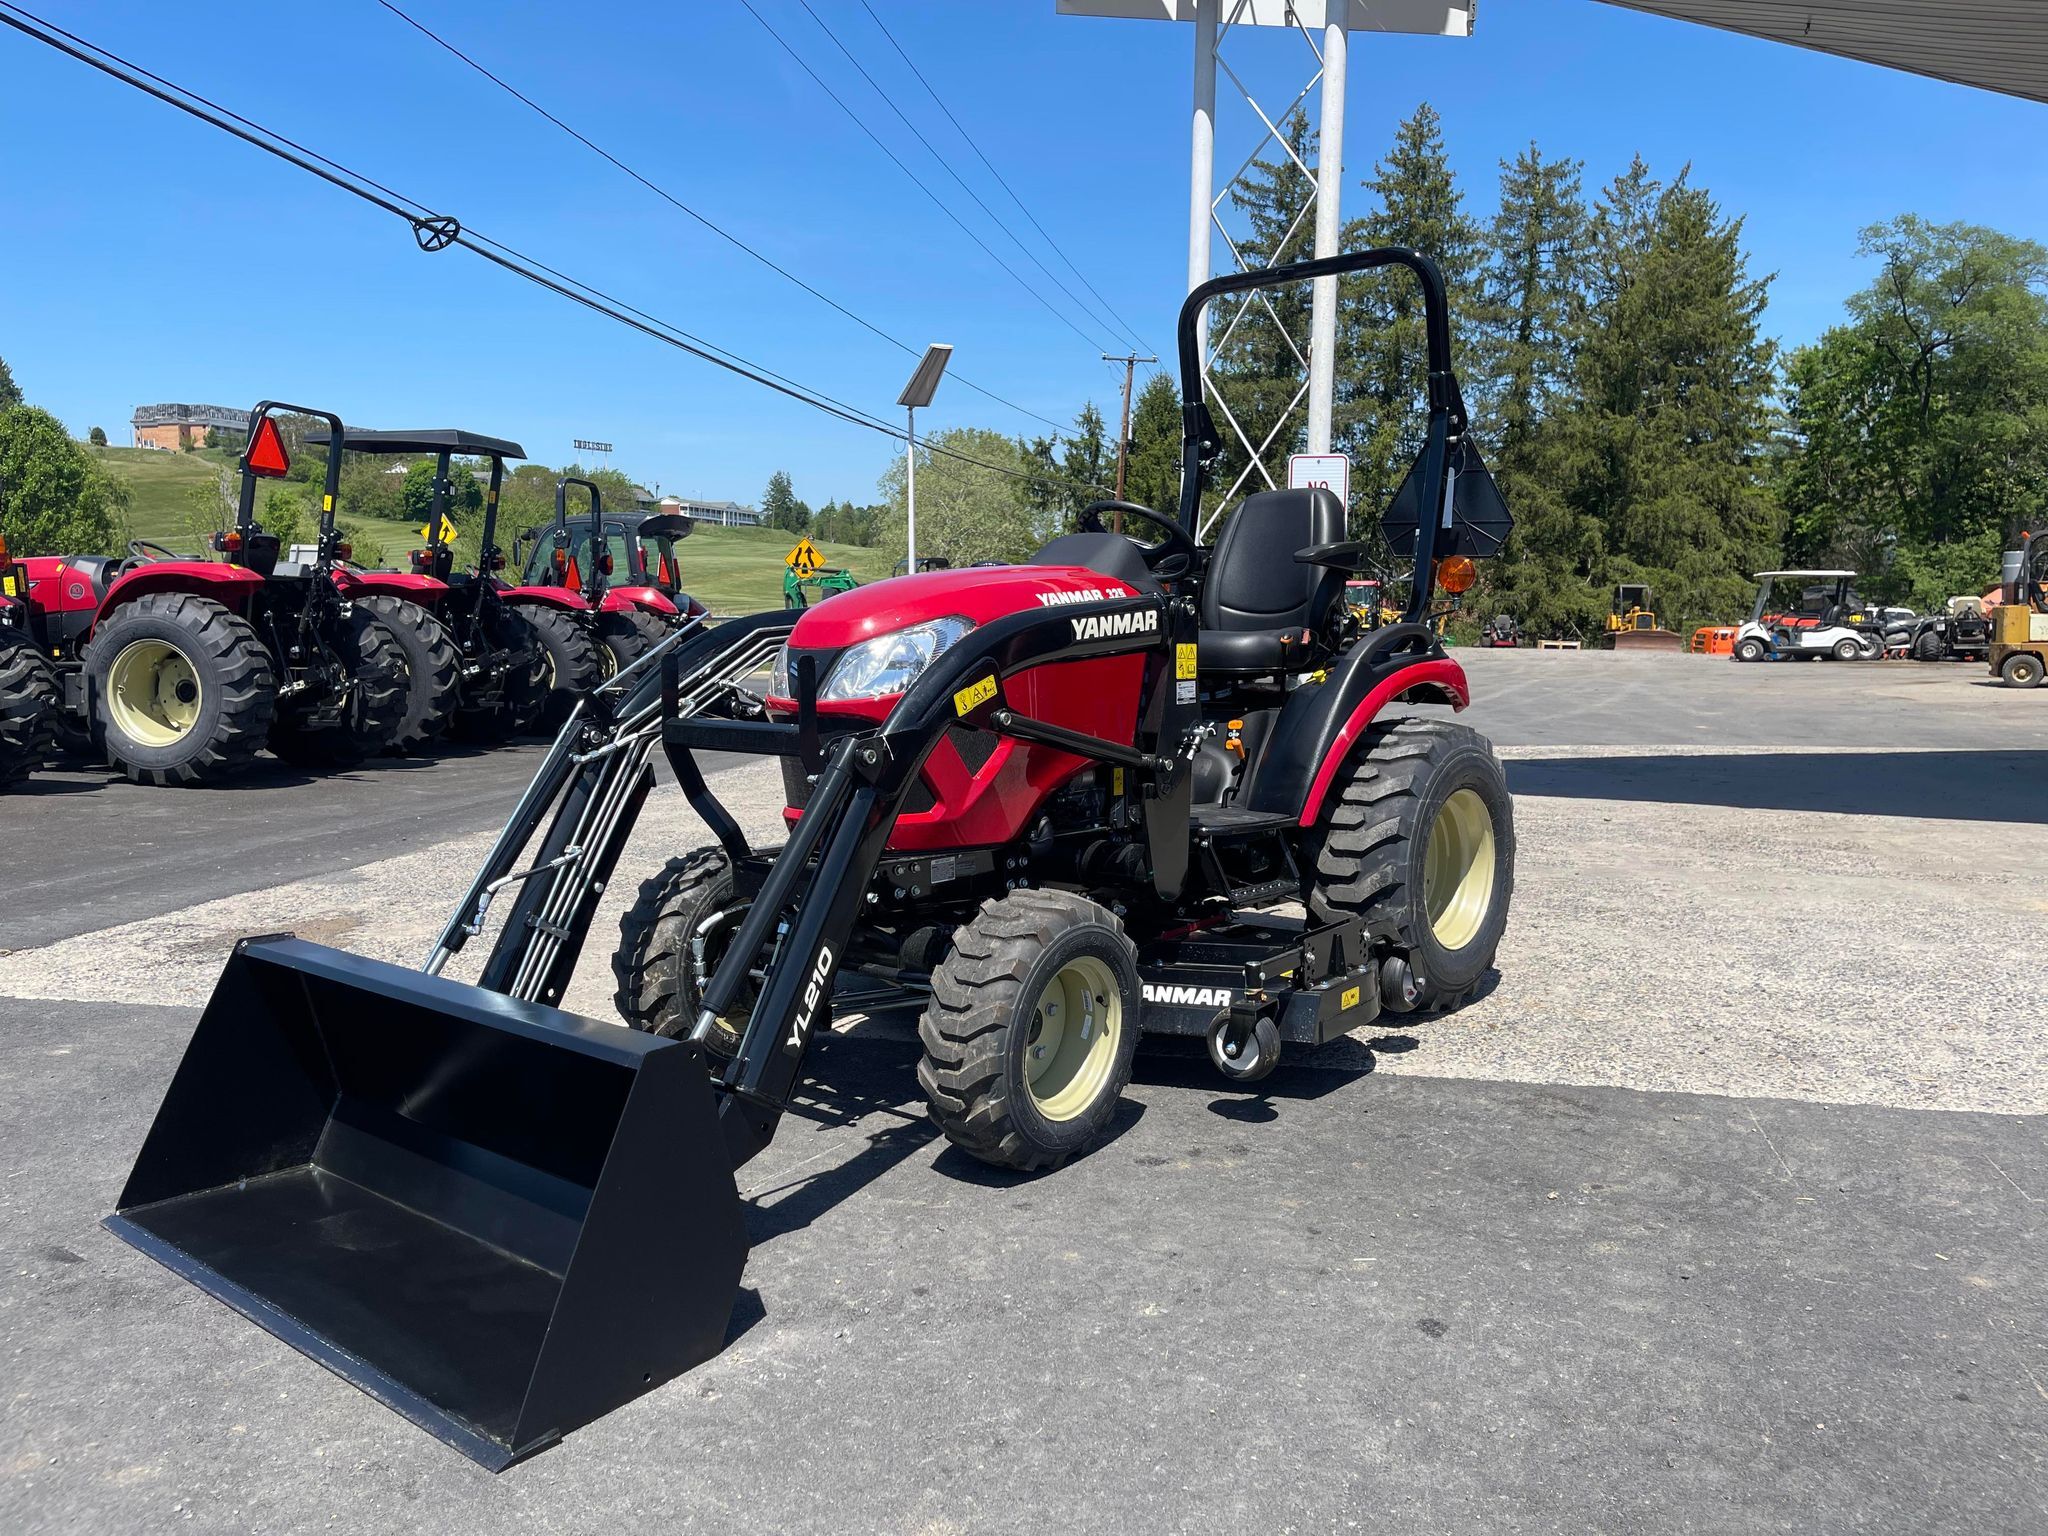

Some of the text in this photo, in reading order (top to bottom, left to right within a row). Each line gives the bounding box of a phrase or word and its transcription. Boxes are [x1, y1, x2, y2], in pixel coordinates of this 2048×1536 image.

[1035, 589, 1104, 607] YANMAR
[1071, 610, 1158, 640] YANMAR
[786, 946, 833, 1048] YL210
[1142, 985, 1232, 1007] ANMAR
